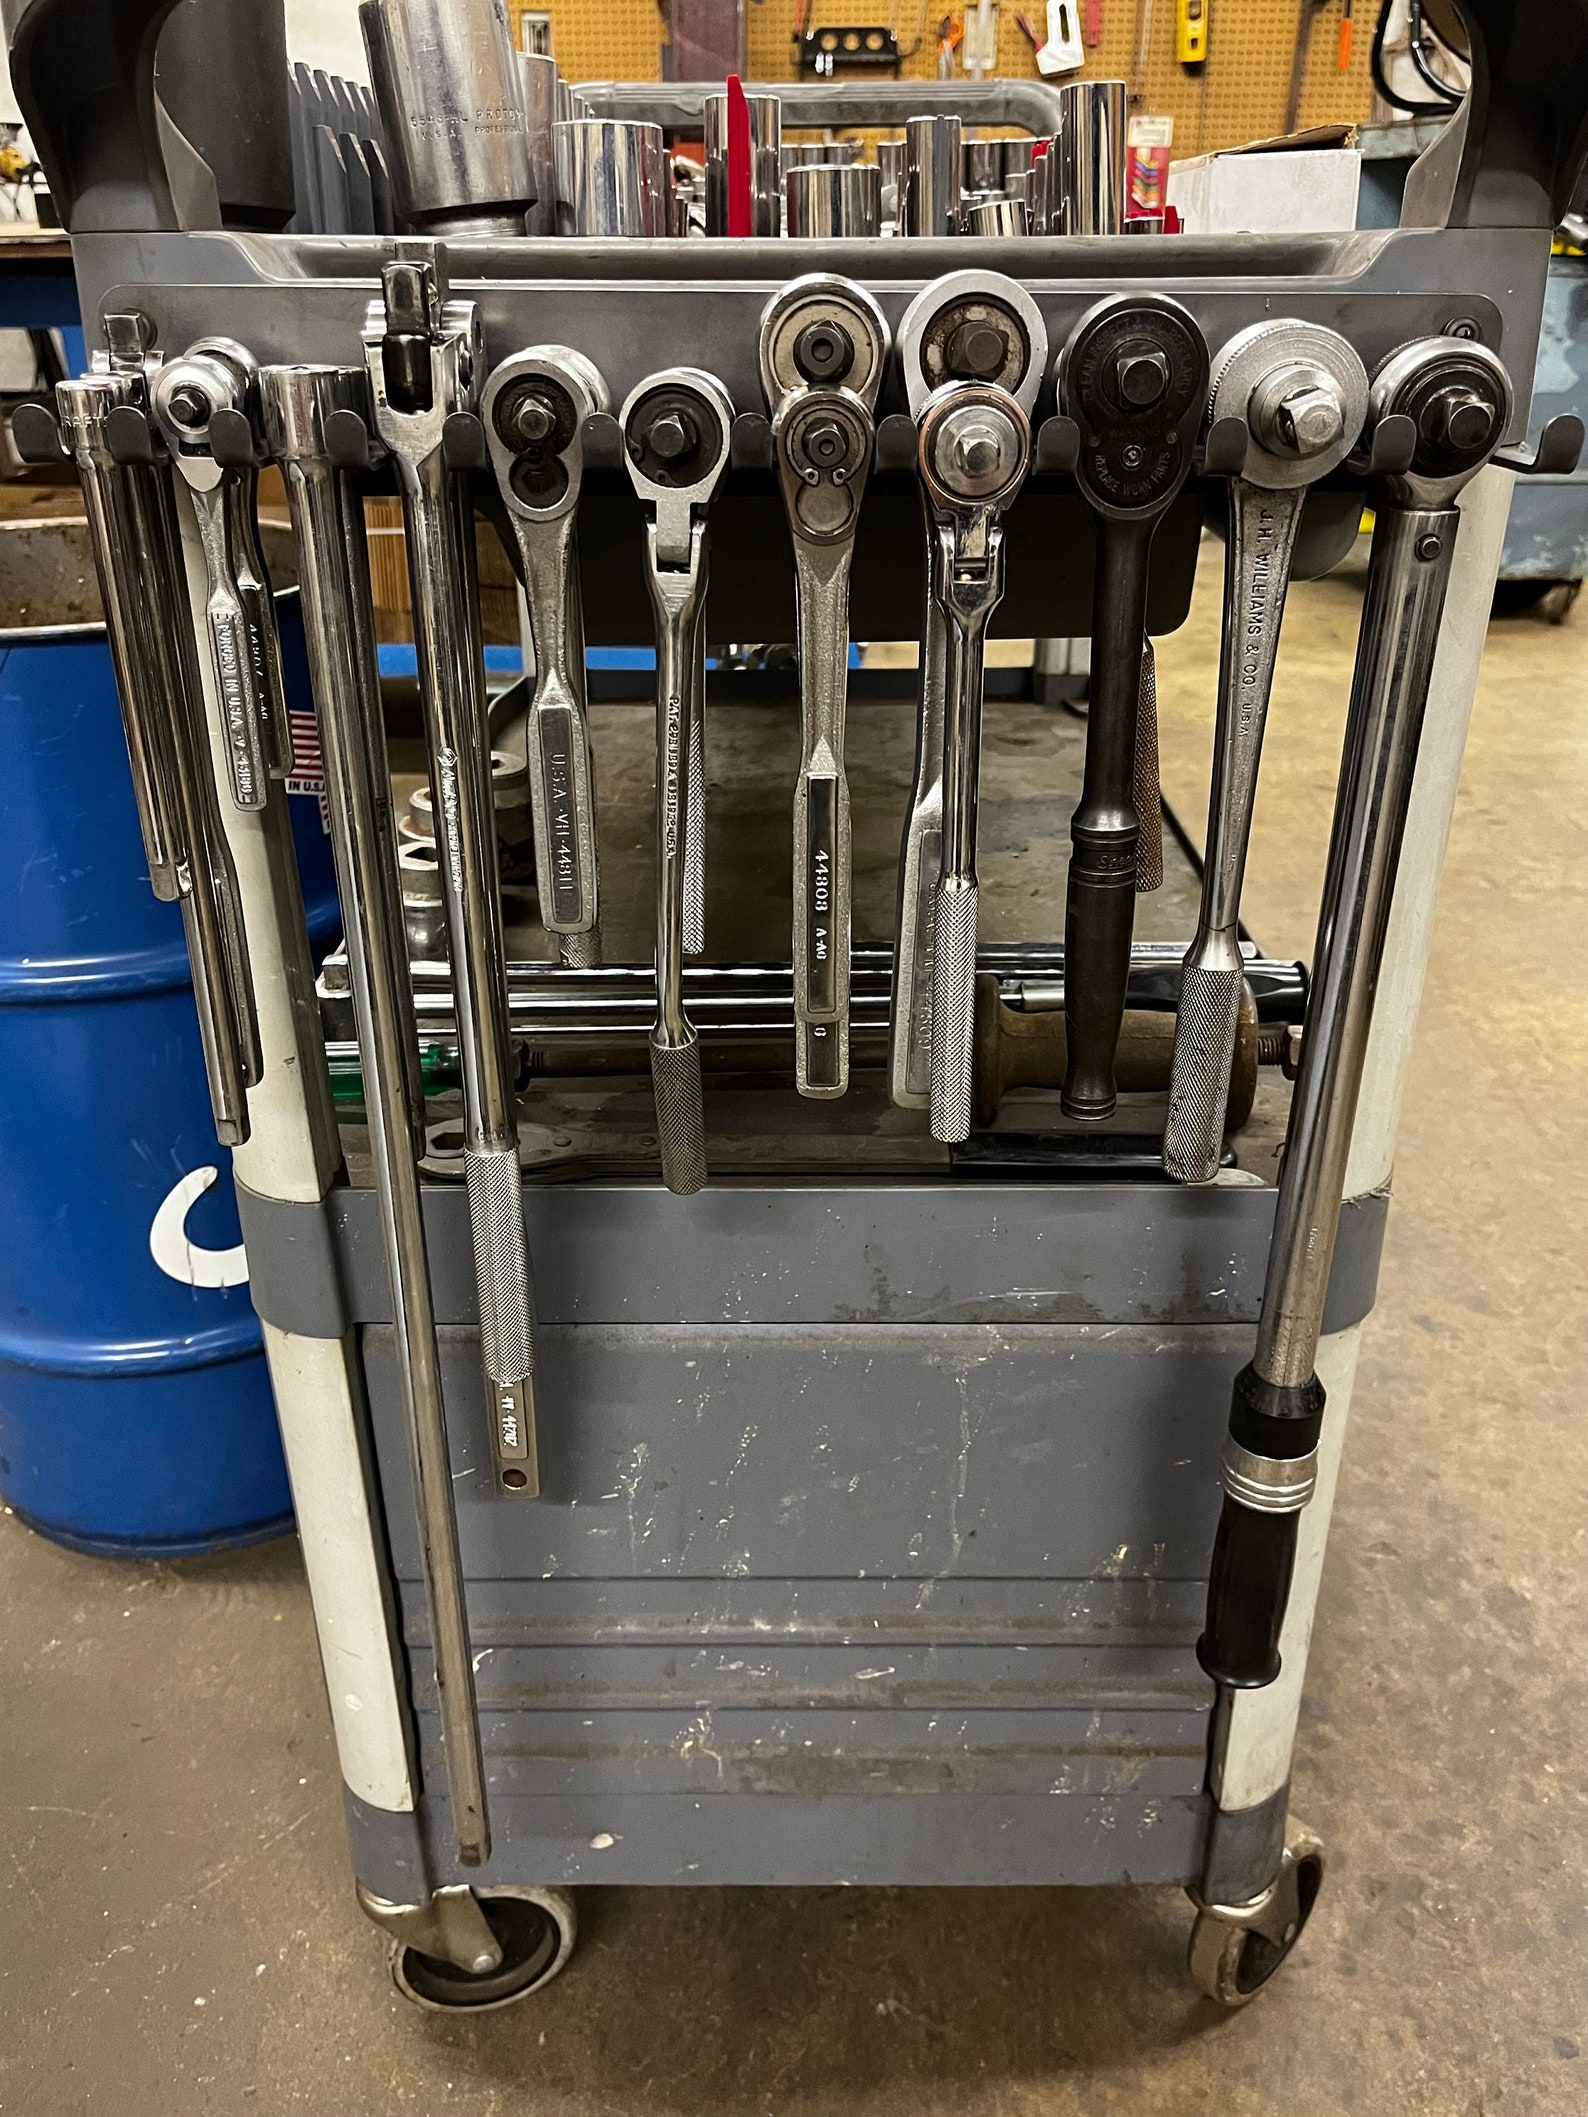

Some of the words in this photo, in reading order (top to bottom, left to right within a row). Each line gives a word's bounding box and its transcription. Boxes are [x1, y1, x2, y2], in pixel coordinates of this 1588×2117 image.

[1095, 454, 1121, 492] REPLACE
[1122, 477, 1152, 496] WORN
[1150, 451, 1171, 485] PARTS
[1247, 552, 1271, 637] WILLIAMS
[217, 624, 237, 674] FORGED
[1245, 644, 1260, 656] &
[224, 679, 240, 693] IN
[1241, 664, 1258, 691] CO.
[288, 780, 301, 792] IN
[814, 849, 830, 912] 44808
